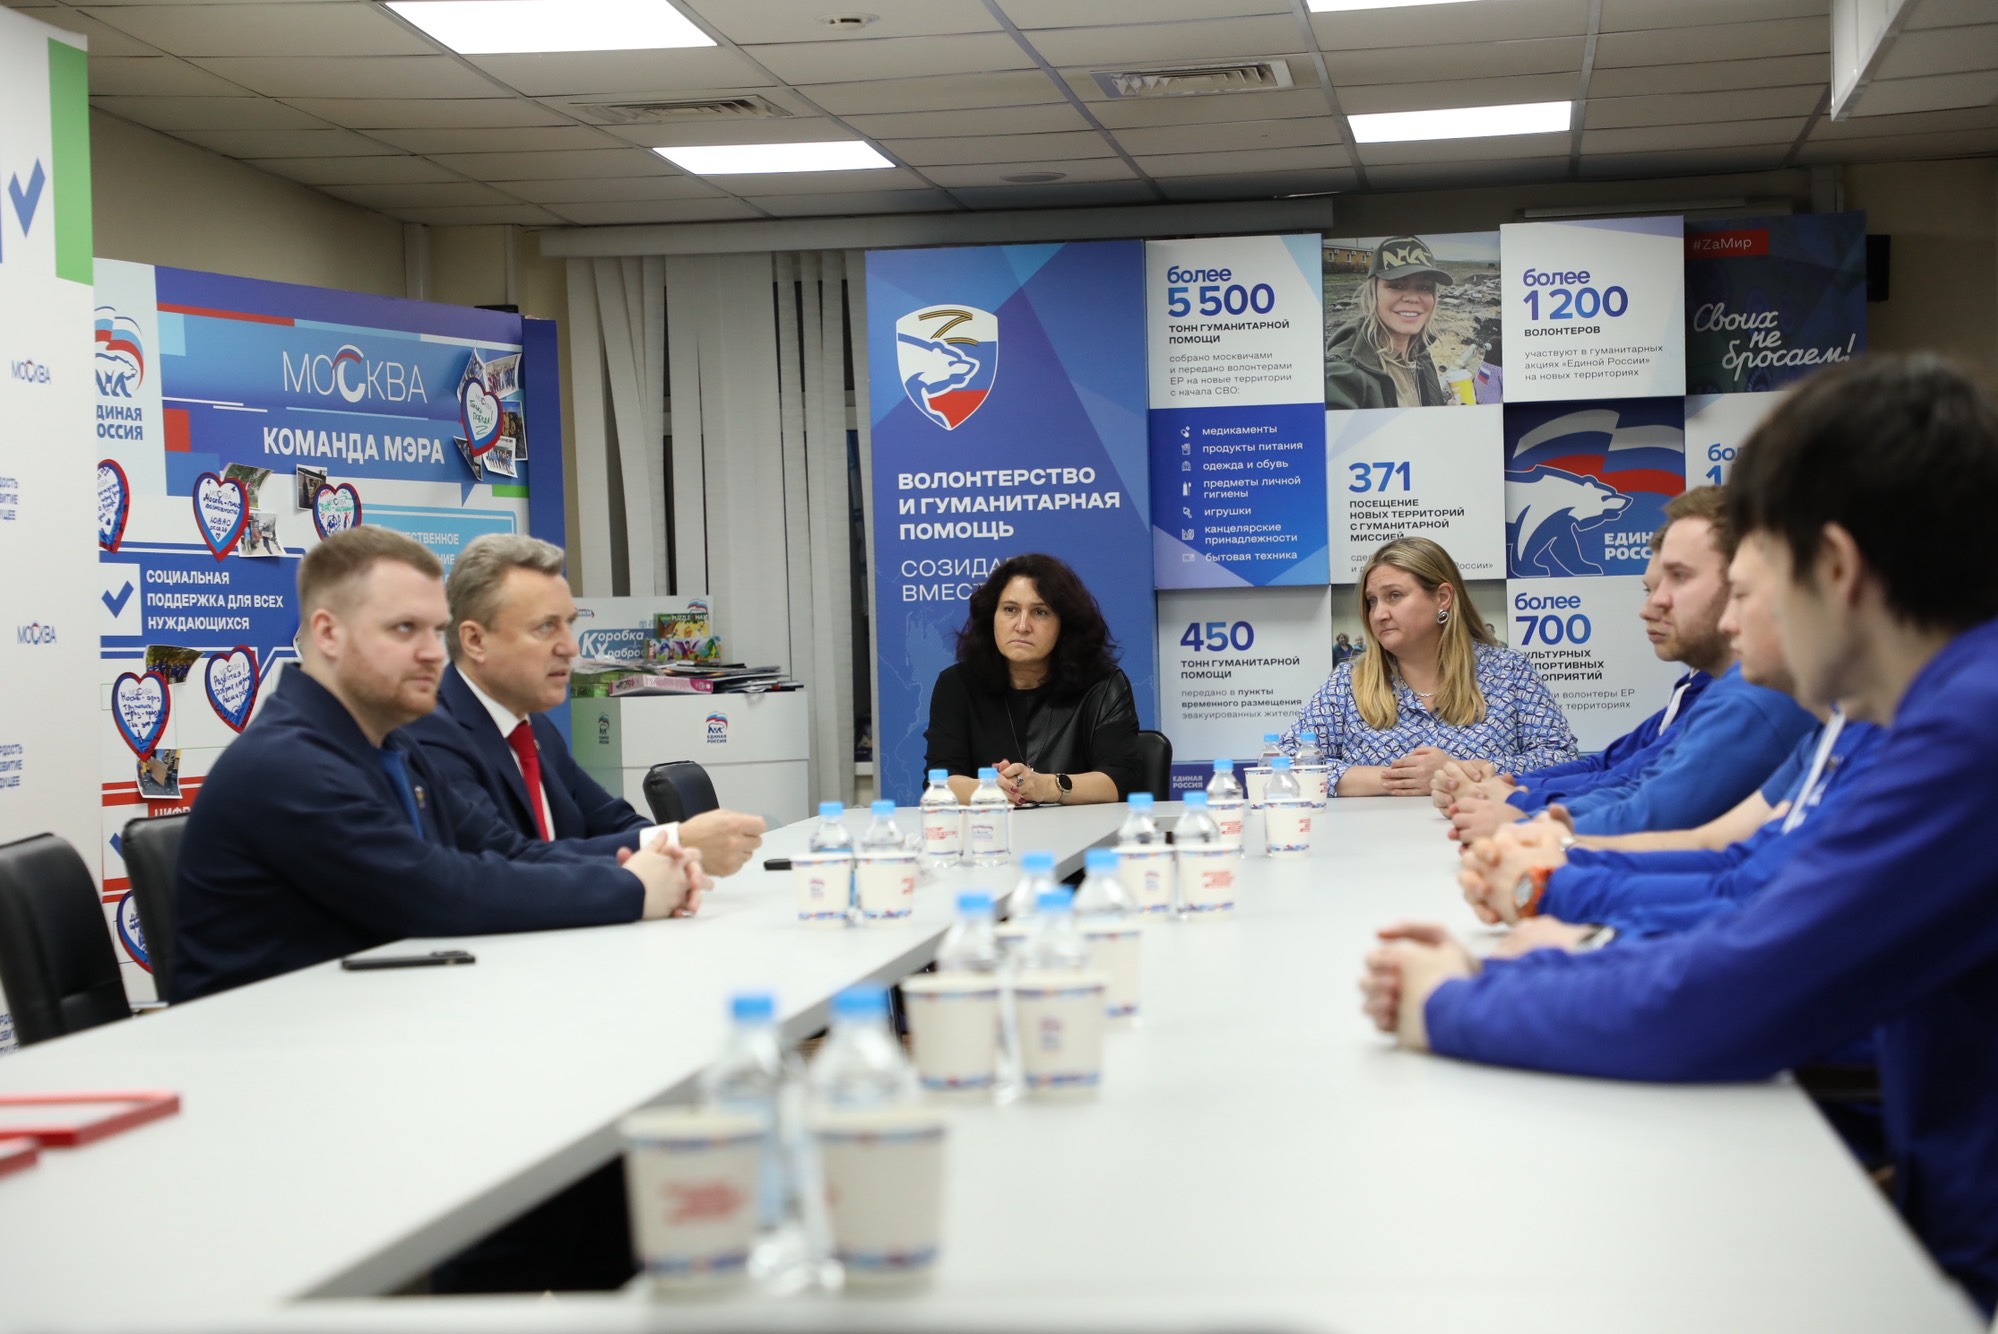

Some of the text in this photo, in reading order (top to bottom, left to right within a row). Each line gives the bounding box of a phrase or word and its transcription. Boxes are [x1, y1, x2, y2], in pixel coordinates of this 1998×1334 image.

[1167, 266, 1231, 283] более
[1523, 268, 1590, 286] более
[1693, 302, 1779, 332] Своих
[1169, 319, 1289, 333] ТОНН ГУМАНИТАРНОЙ
[1525, 326, 1600, 337] ВОЛОНТЕРОВ
[1169, 335, 1220, 344] ПОМОЩИ
[1749, 330, 1782, 348] не
[1170, 352, 1272, 364] собрано москвичами
[1525, 349, 1577, 359] участвуют
[1590, 345, 1663, 356] гуманитарных
[1722, 333, 1856, 381] бросаем!
[1179, 366, 1224, 374] передано
[1228, 363, 1292, 372] волонтерами
[1525, 358, 1650, 370] акциях «Единой России»
[11, 359, 52, 385] МОСКВА
[282, 344, 428, 403] МОСКВА
[1540, 372, 1570, 380] новых
[1574, 370, 1639, 380] территориях
[1170, 377, 1184, 385] ЕР
[1201, 376, 1231, 384] новые
[1235, 375, 1292, 383] территории
[1179, 388, 1212, 396] начала
[1215, 387, 1240, 395] СВО:
[96, 405, 143, 422] ДИНАЯ
[97, 423, 143, 440] ОССИЯ
[1203, 426, 1277, 436] медикаменты
[263, 427, 445, 464] КОМАНДА МЭРА
[1203, 442, 1303, 454] продукты питания
[1203, 461, 1244, 471] одежда
[1257, 459, 1288, 470] обувь
[899, 467, 1096, 490] ВОЛОНТЕРСТВО
[1204, 476, 1301, 488] предметы личной
[1349, 461, 1410, 493] 371
[1204, 490, 1248, 498] гигиены
[899, 492, 1121, 515] И ГУМАНИТАРНАЯ
[1350, 499, 1419, 508] ПОСЕЩЕНИЕ
[1204, 507, 1251, 517] игрушки
[1350, 507, 1464, 519] НОВЫХ ТЕРРИТОРИЙ
[900, 521, 1014, 541] ПОМОЩЬ
[1205, 524, 1281, 534] канцелярские
[1360, 521, 1449, 530] ГУМАНИТАРНОЙ
[1205, 535, 1297, 545] принадлежности
[1605, 532, 1653, 545] ЕДИН
[1205, 552, 1297, 562] бытовая техника
[1605, 548, 1652, 560] РОСС
[901, 557, 1003, 578] СОЗИДА
[146, 570, 229, 585] СОЦИАЛЬНАЯ
[902, 583, 977, 602] ВМЕС
[147, 593, 284, 609] ПОДДЕРЖКА ДЛЯ ВСЕХ
[1515, 592, 1581, 610] более
[148, 616, 250, 632] НУЖДАЮЩИХСЯ
[1516, 613, 1591, 645] 700
[17, 622, 57, 645] МОСКВА
[1180, 621, 1254, 652] 450
[581, 629, 644, 656] Коробка
[596, 641, 643, 660] Храбро
[1526, 650, 1591, 659] УЛЬТУРНЫХ
[1181, 656, 1300, 668] ТОНН ГУМАНИТАРНОЙ
[1534, 661, 1604, 669] ПОРТИВНЫХ
[1181, 671, 1231, 679] ПОМОЩИ
[1542, 671, 1602, 681] ОПРИЯТИЙ
[1182, 689, 1227, 697] передано
[1238, 688, 1273, 697] пункты
[1563, 691, 1617, 700] волонтеры
[1621, 689, 1635, 697] ЕР
[1182, 699, 1301, 708] временного размещения
[1566, 702, 1630, 710] территориях
[1182, 711, 1262, 720] эвакуированных
